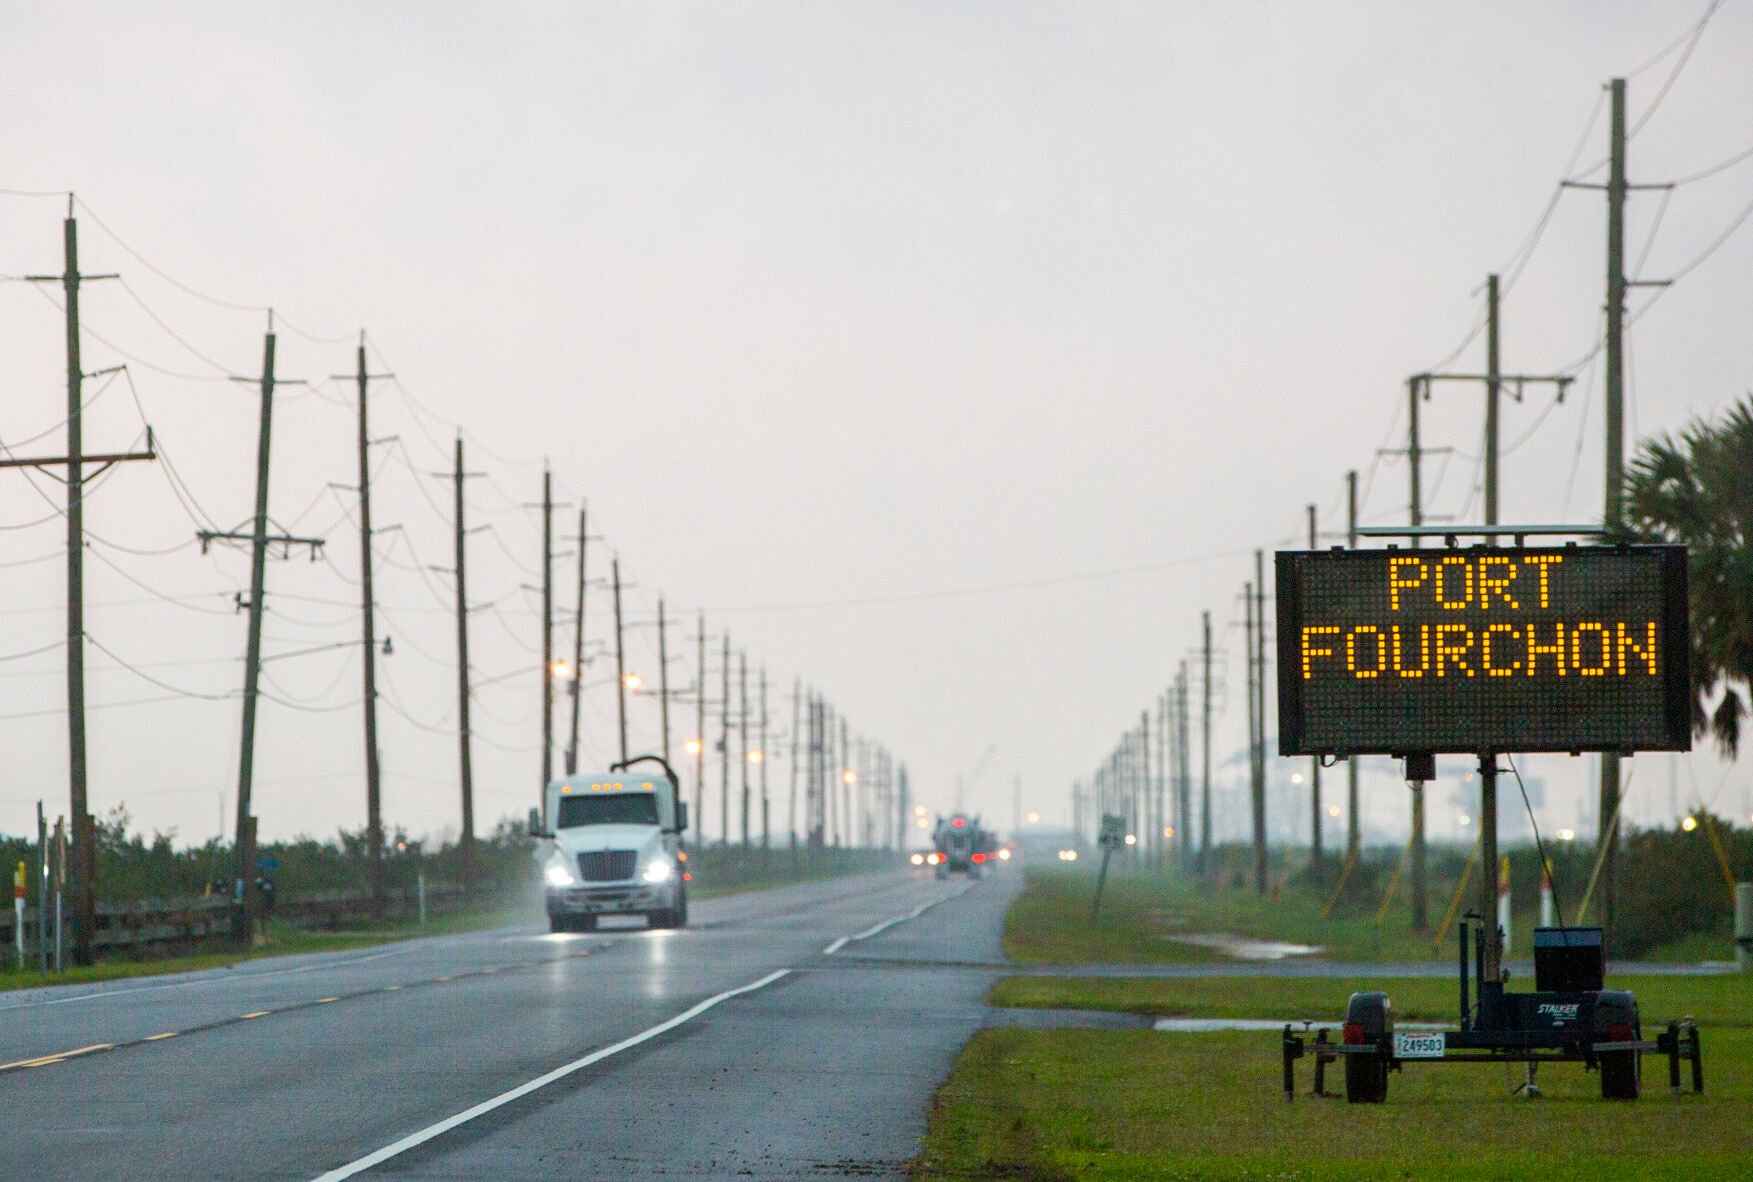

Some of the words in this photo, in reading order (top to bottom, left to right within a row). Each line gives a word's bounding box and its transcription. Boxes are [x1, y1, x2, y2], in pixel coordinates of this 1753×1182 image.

[1390, 555, 1563, 610] PORT
[1302, 621, 1657, 679] FOURCHON
[1537, 1003, 1580, 1014] STALKER
